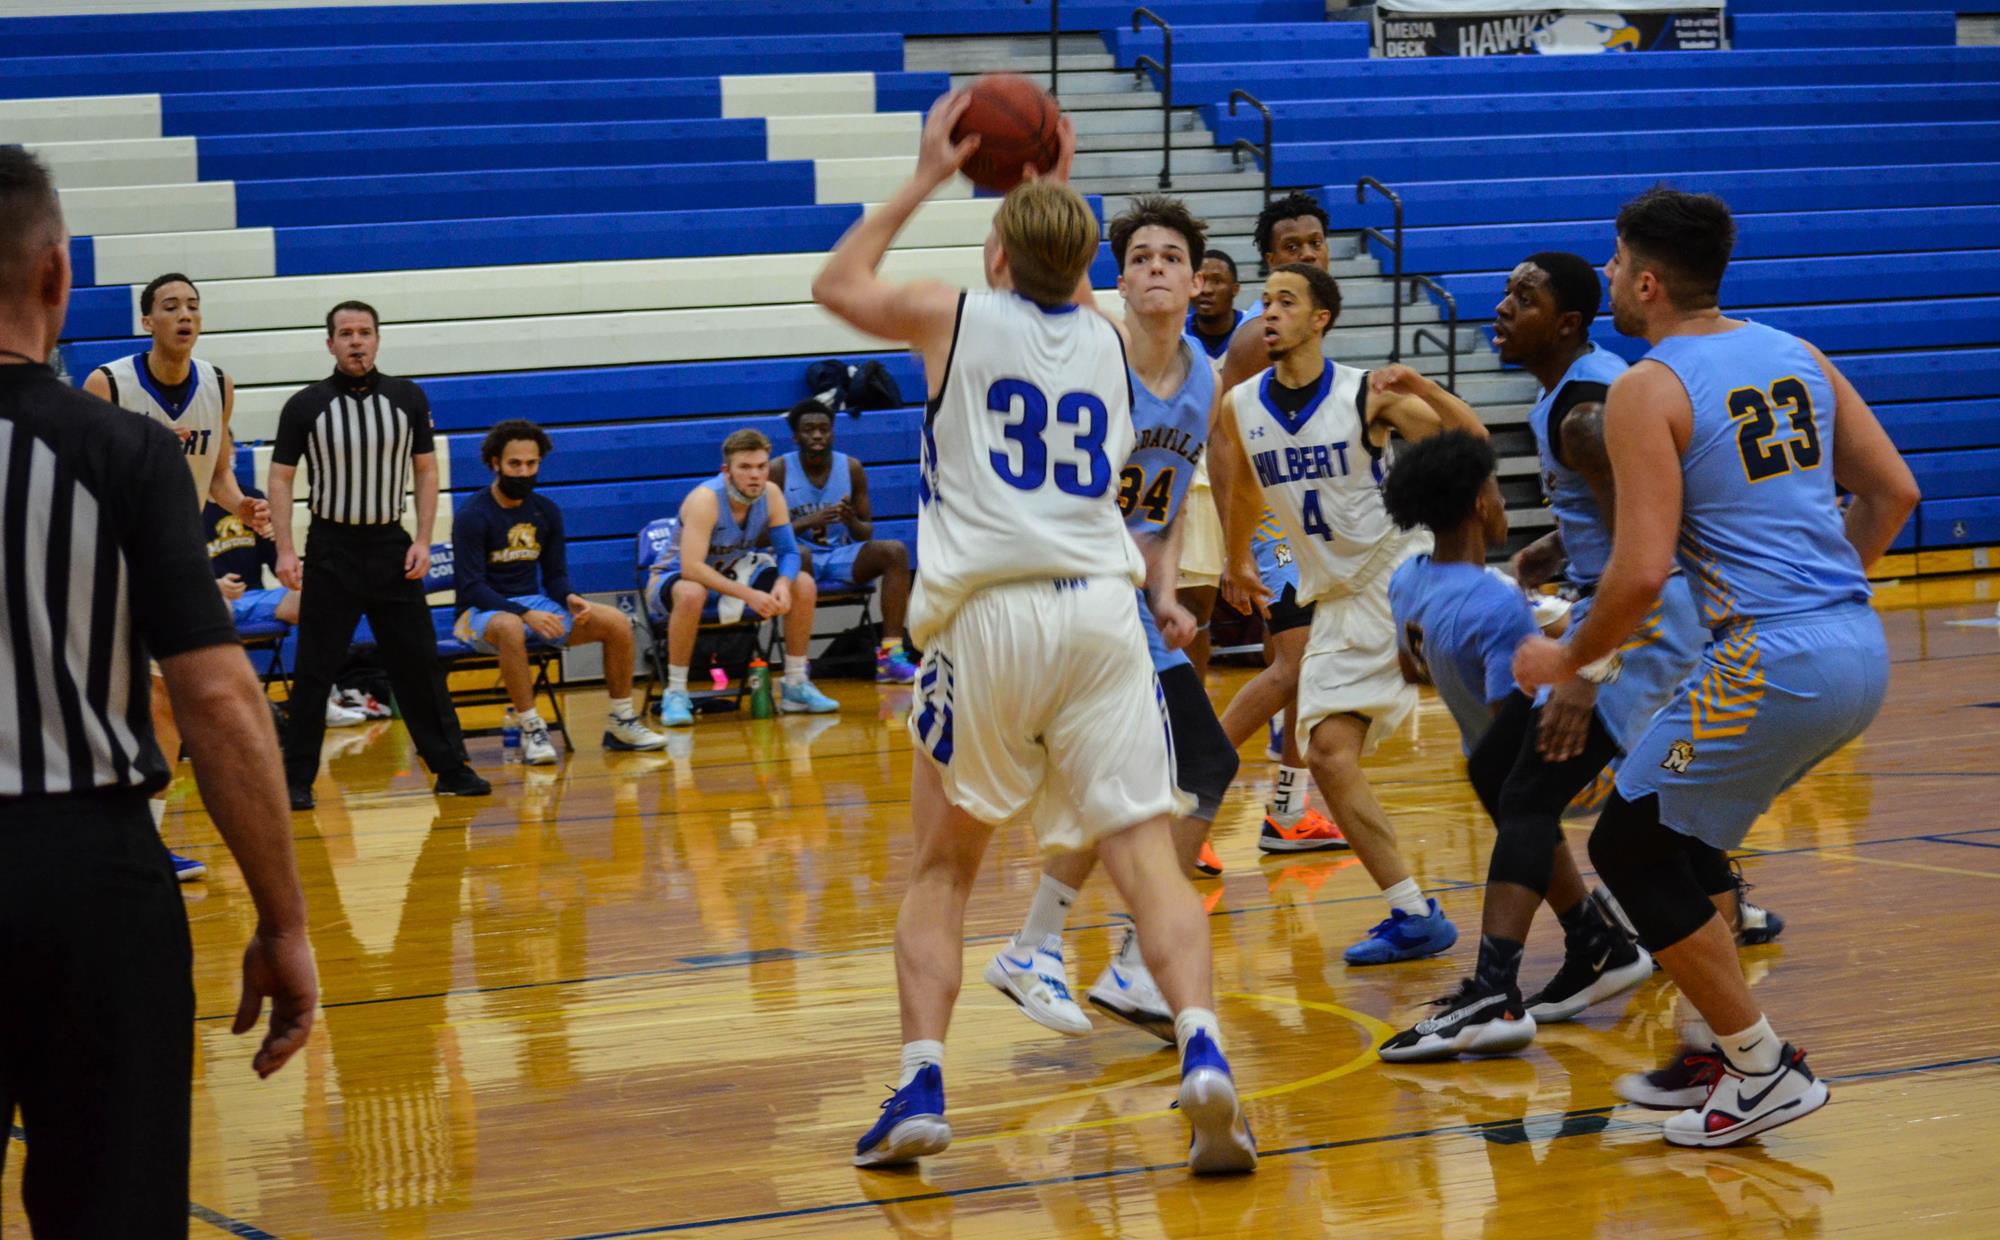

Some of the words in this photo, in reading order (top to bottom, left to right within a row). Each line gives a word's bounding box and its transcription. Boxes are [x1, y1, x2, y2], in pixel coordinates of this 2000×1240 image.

[1385, 22, 1436, 39] MEDIA
[1386, 41, 1427, 58] DECK
[986, 377, 1112, 499] 33
[1132, 427, 1204, 467] DAILLE
[1725, 375, 1822, 485] 23
[1117, 464, 1176, 526] 34
[1303, 489, 1334, 541] 4
